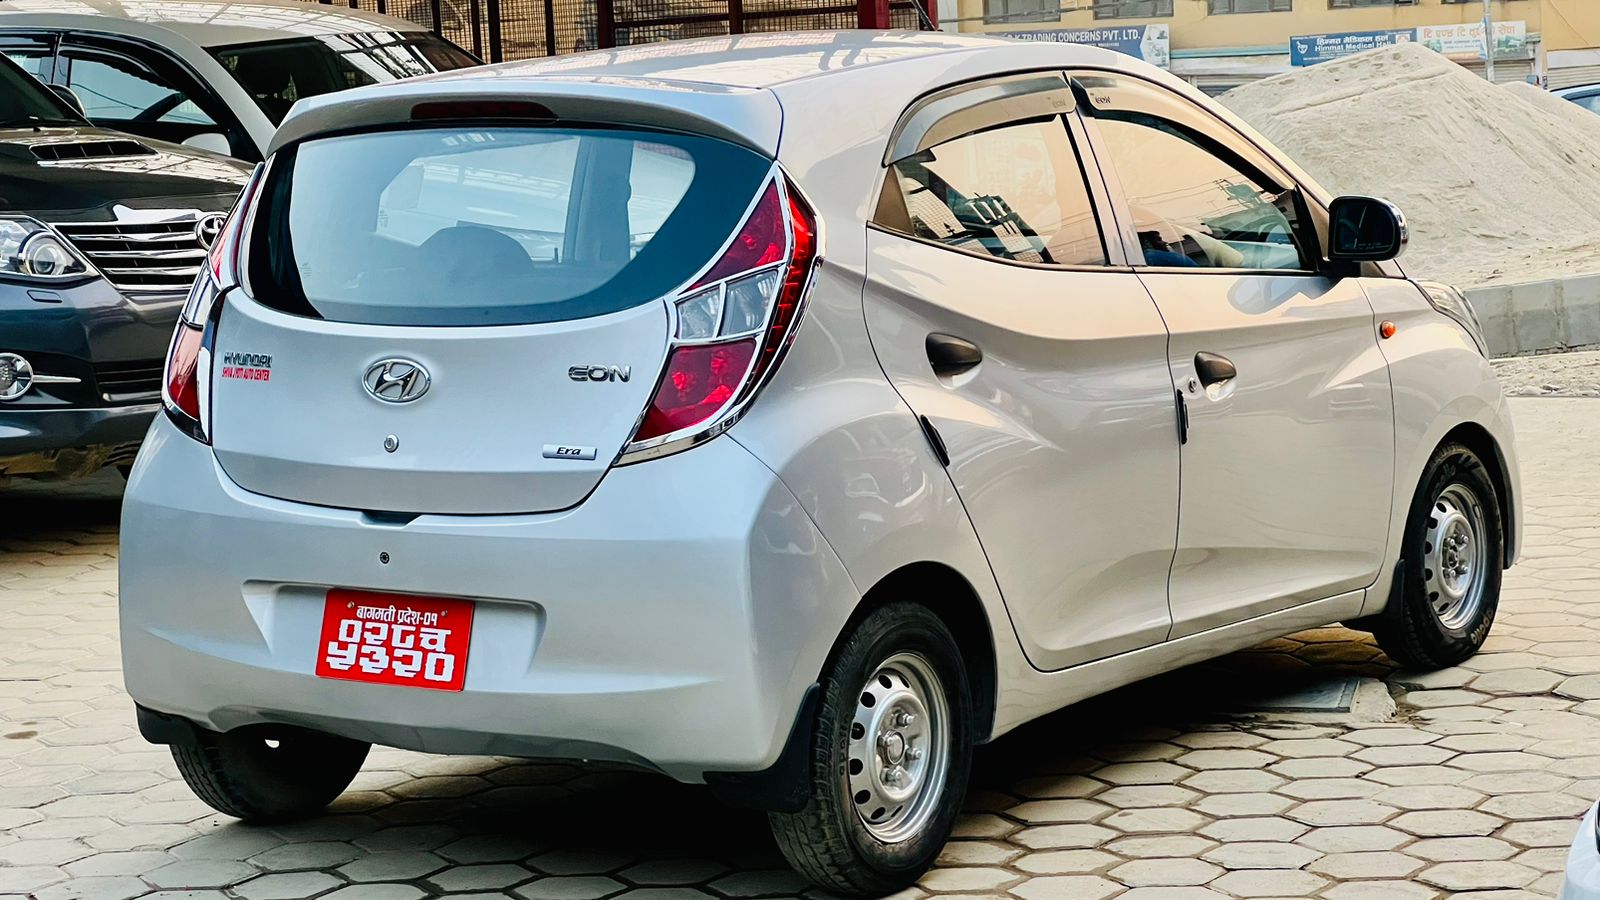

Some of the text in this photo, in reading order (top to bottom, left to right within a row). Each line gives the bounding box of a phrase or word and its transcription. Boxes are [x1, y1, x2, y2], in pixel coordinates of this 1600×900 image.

[1058, 31, 1100, 42] CONCERNS
[1103, 30, 1121, 40] PVT.
[1123, 29, 1140, 39] LTD.
[1314, 44, 1344, 52] Himmat
[1345, 41, 1375, 50] Medical
[568, 365, 631, 383] EON
[556, 446, 582, 456] Era
[356, 604, 396, 623] बागमती
